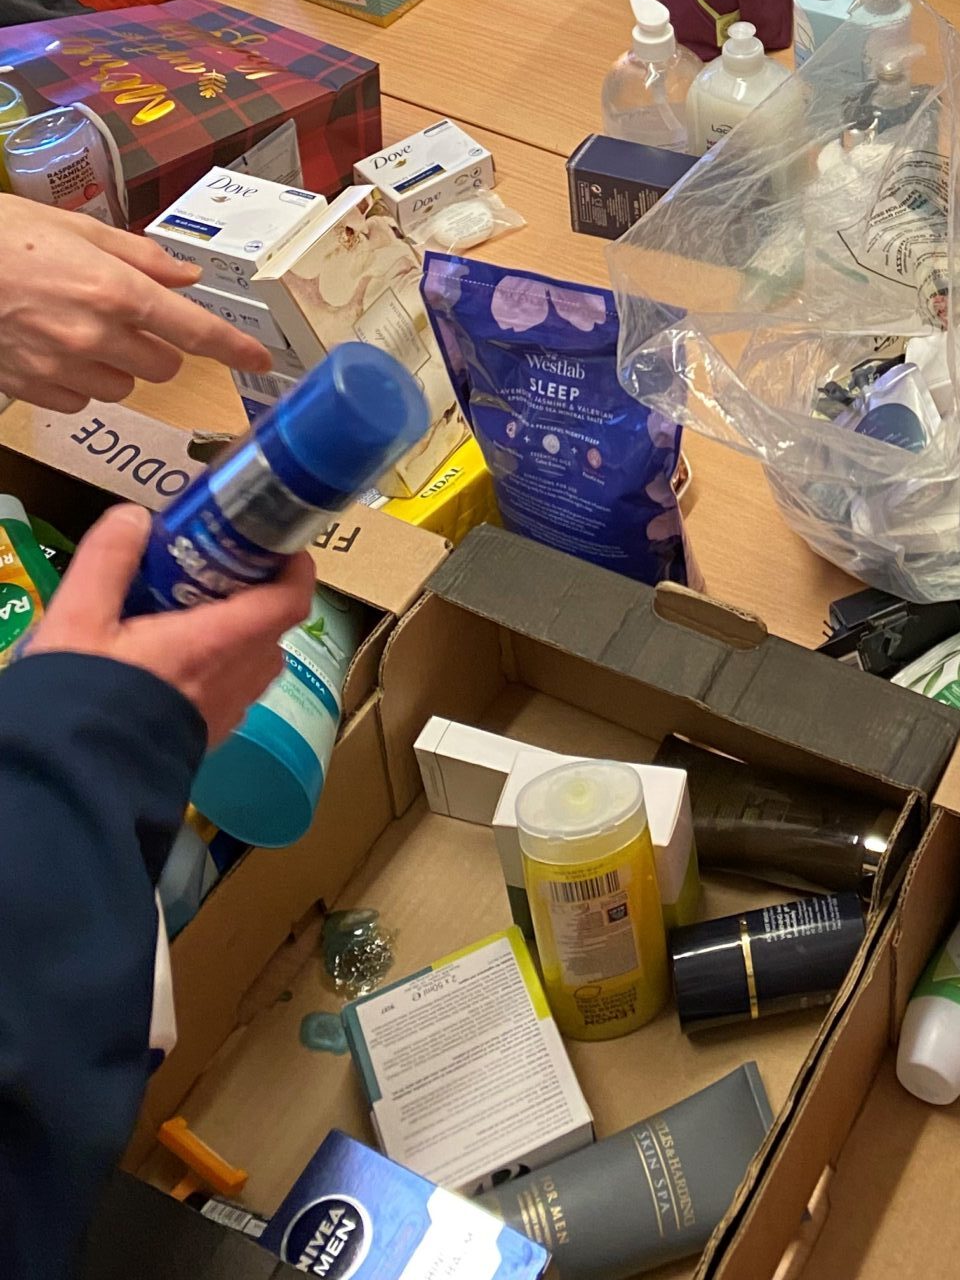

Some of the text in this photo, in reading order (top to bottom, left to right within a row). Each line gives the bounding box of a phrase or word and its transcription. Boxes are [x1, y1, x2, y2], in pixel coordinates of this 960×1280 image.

[46, 154, 89, 179] RASPBERRY
[370, 144, 413, 169] Dove
[57, 161, 90, 181] VANILLA
[206, 175, 259, 198] Dove
[413, 192, 442, 212] Dove
[525, 353, 586, 380] Westlab
[529, 377, 580, 401] SLEEP
[534, 395, 566, 409] JASMINE
[71, 418, 191, 496] ODUCE
[420, 468, 464, 498] CIDAL
[305, 671, 326, 695] VERA
[637, 1130, 670, 1214] SKIN SPA
[550, 1205, 569, 1246] MEN
[295, 1206, 346, 1272] NIVEA
[313, 1219, 356, 1277] MEN
